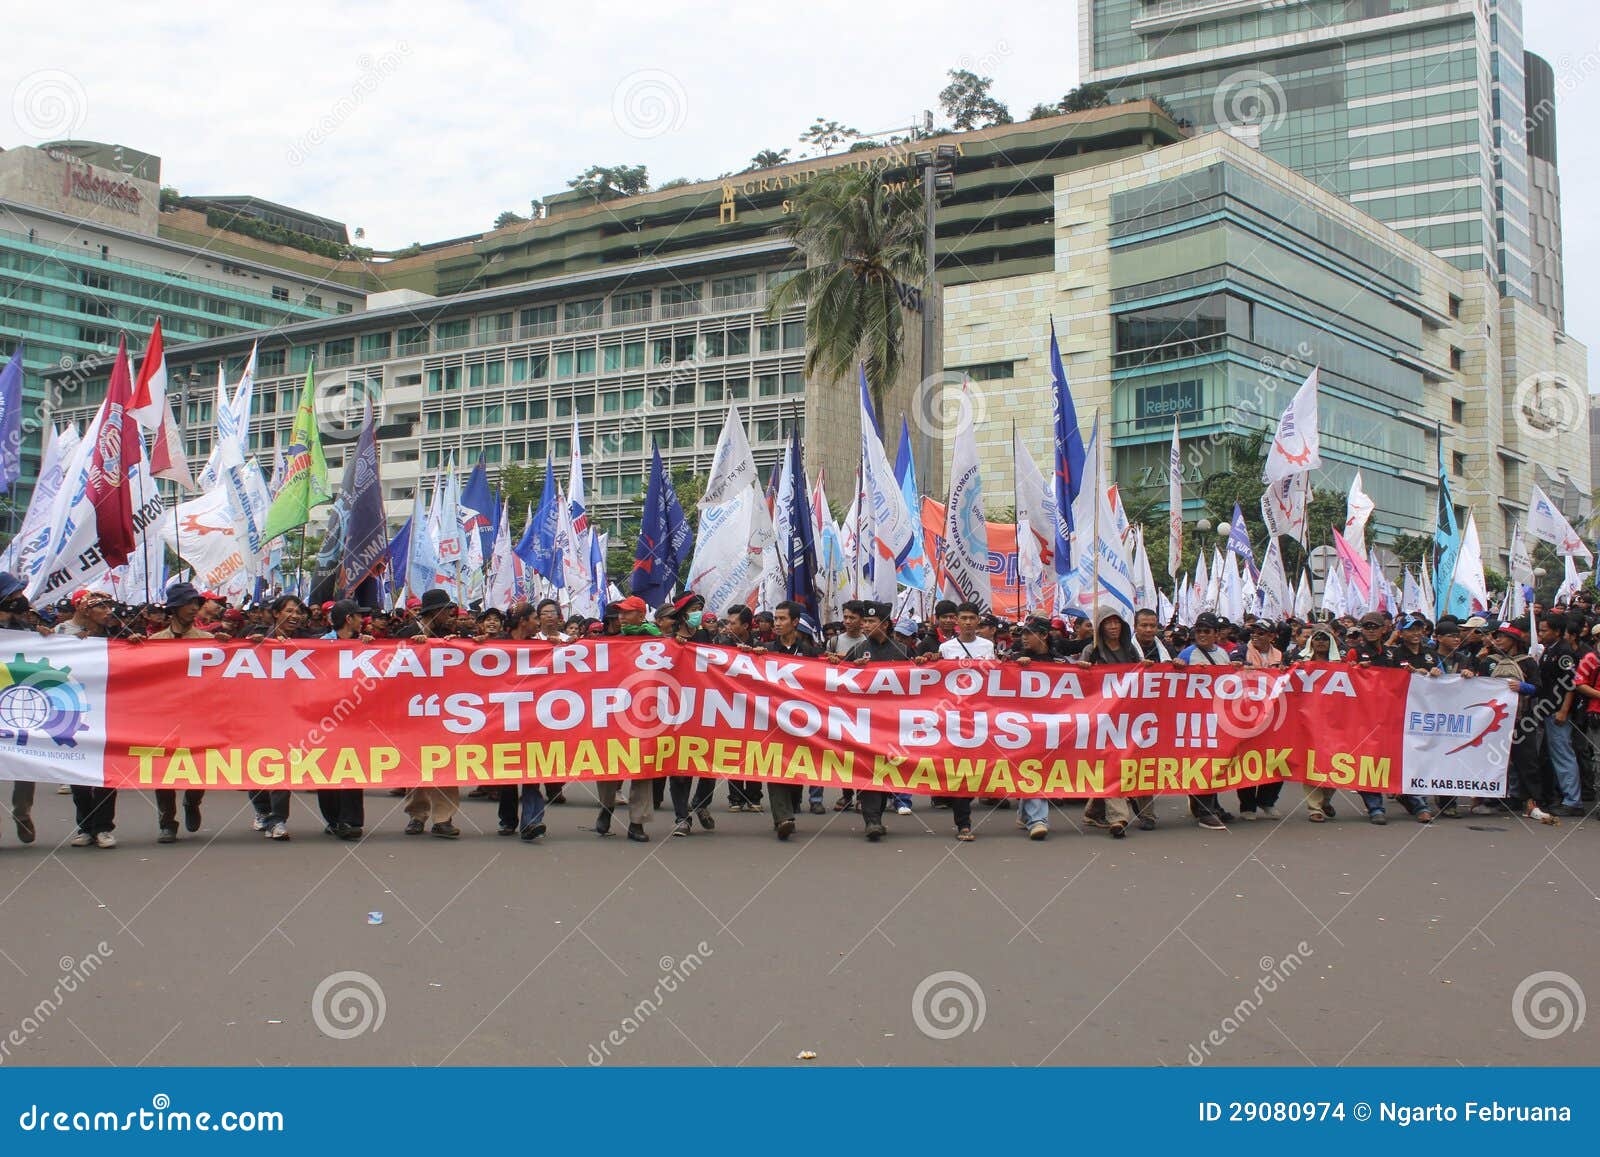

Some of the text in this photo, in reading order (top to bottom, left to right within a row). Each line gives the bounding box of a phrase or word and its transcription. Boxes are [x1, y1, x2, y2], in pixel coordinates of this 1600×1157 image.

[1146, 396, 1192, 414] Reebok
[950, 465, 978, 512] AUTOMOTIF
[1139, 465, 1204, 487] ZARA
[187, 641, 1358, 700] PAK KAPOLRI & PAK KAPOLDA METROJAYA
[657, 686, 871, 744] UNION
[898, 709, 1159, 750] BUSTING
[1174, 712, 1219, 748] !!!
[1409, 711, 1473, 734] FSPMI
[128, 736, 1392, 793] TANGKAP PREMAN-PREMAN KAWASAN BERKEDOK LSM
[1410, 778, 1501, 792] KC. KAB.BEKASI
